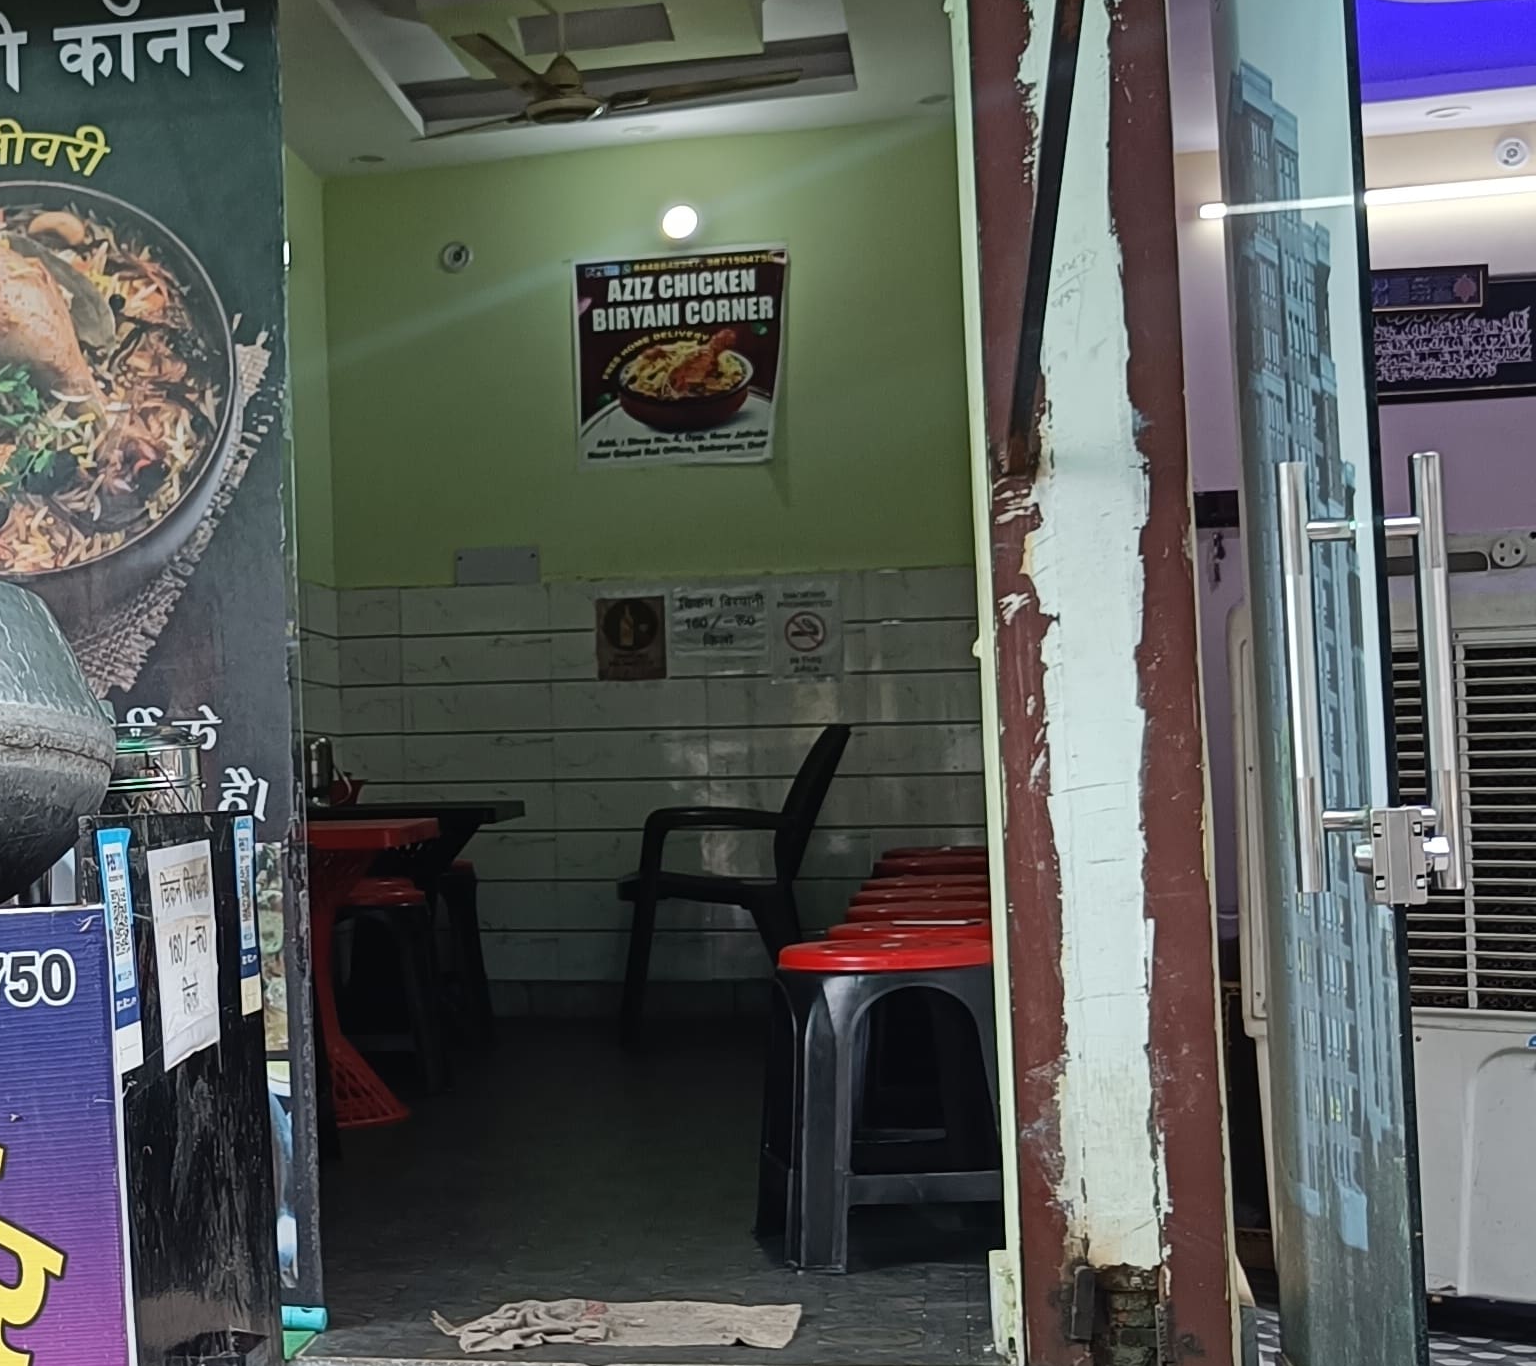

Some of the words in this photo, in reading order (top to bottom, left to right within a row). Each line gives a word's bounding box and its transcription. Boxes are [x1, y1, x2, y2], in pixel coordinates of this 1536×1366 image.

[607, 276, 654, 303] AZIZ
[658, 268, 756, 299] CHICKEN
[592, 301, 679, 332] BIRYANI
[684, 295, 774, 325] CORNER
